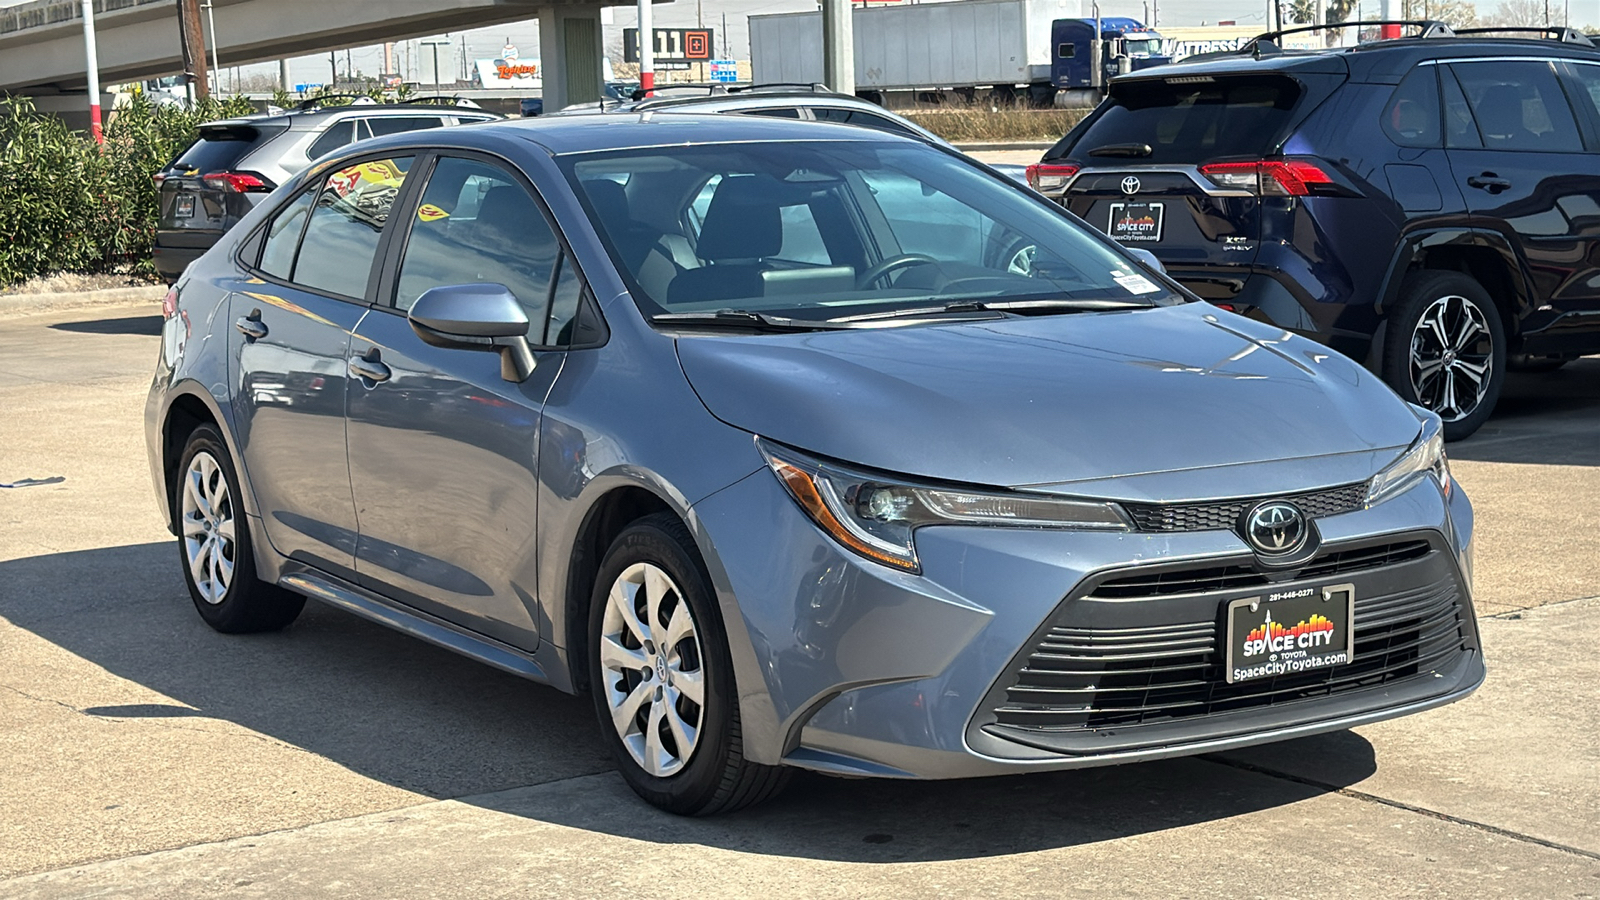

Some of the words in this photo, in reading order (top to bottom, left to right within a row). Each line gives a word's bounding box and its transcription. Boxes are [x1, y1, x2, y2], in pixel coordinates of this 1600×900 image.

[1117, 222, 1138, 231] SPACE
[1138, 223, 1155, 231] CITY
[1269, 588, 1314, 602] 281-446-0271
[1243, 631, 1295, 657] SPACE
[1297, 629, 1334, 649] CITY
[1280, 650, 1308, 660] TOYOTA
[1233, 652, 1347, 681] SpaceCityToyota.com
